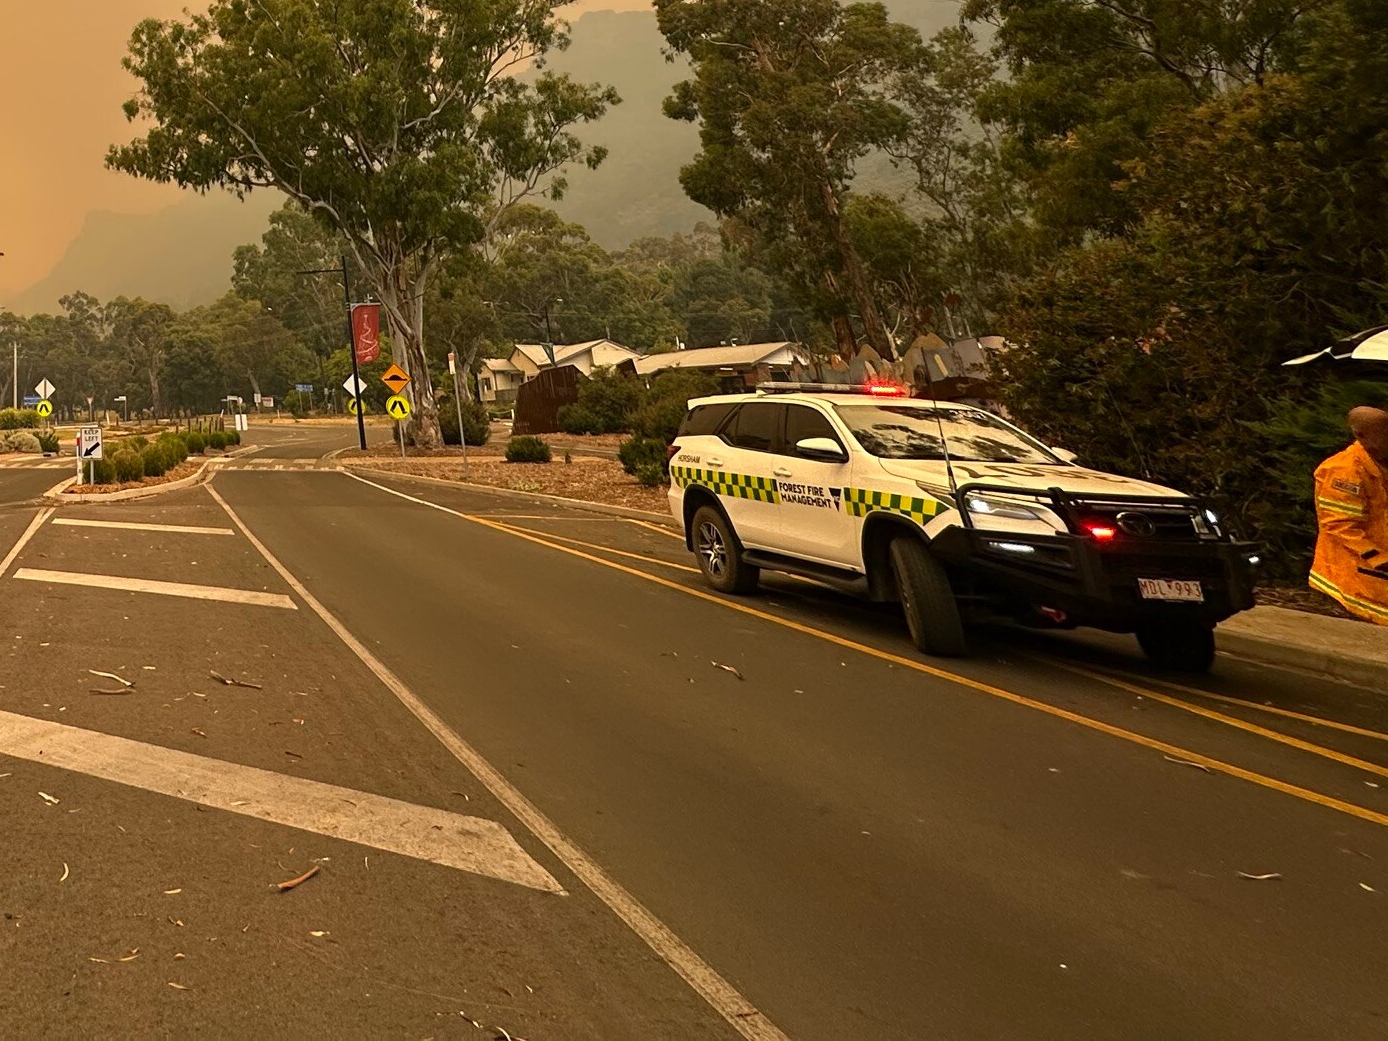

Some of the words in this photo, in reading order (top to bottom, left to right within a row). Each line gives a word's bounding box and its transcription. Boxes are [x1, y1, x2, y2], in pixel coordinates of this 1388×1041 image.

[678, 455, 700, 463] HORSHAM
[779, 482, 806, 495] FOREST
[807, 485, 824, 497] FIRE
[780, 492, 832, 509] MANAGEMENT
[1174, 582, 1201, 597] 993
